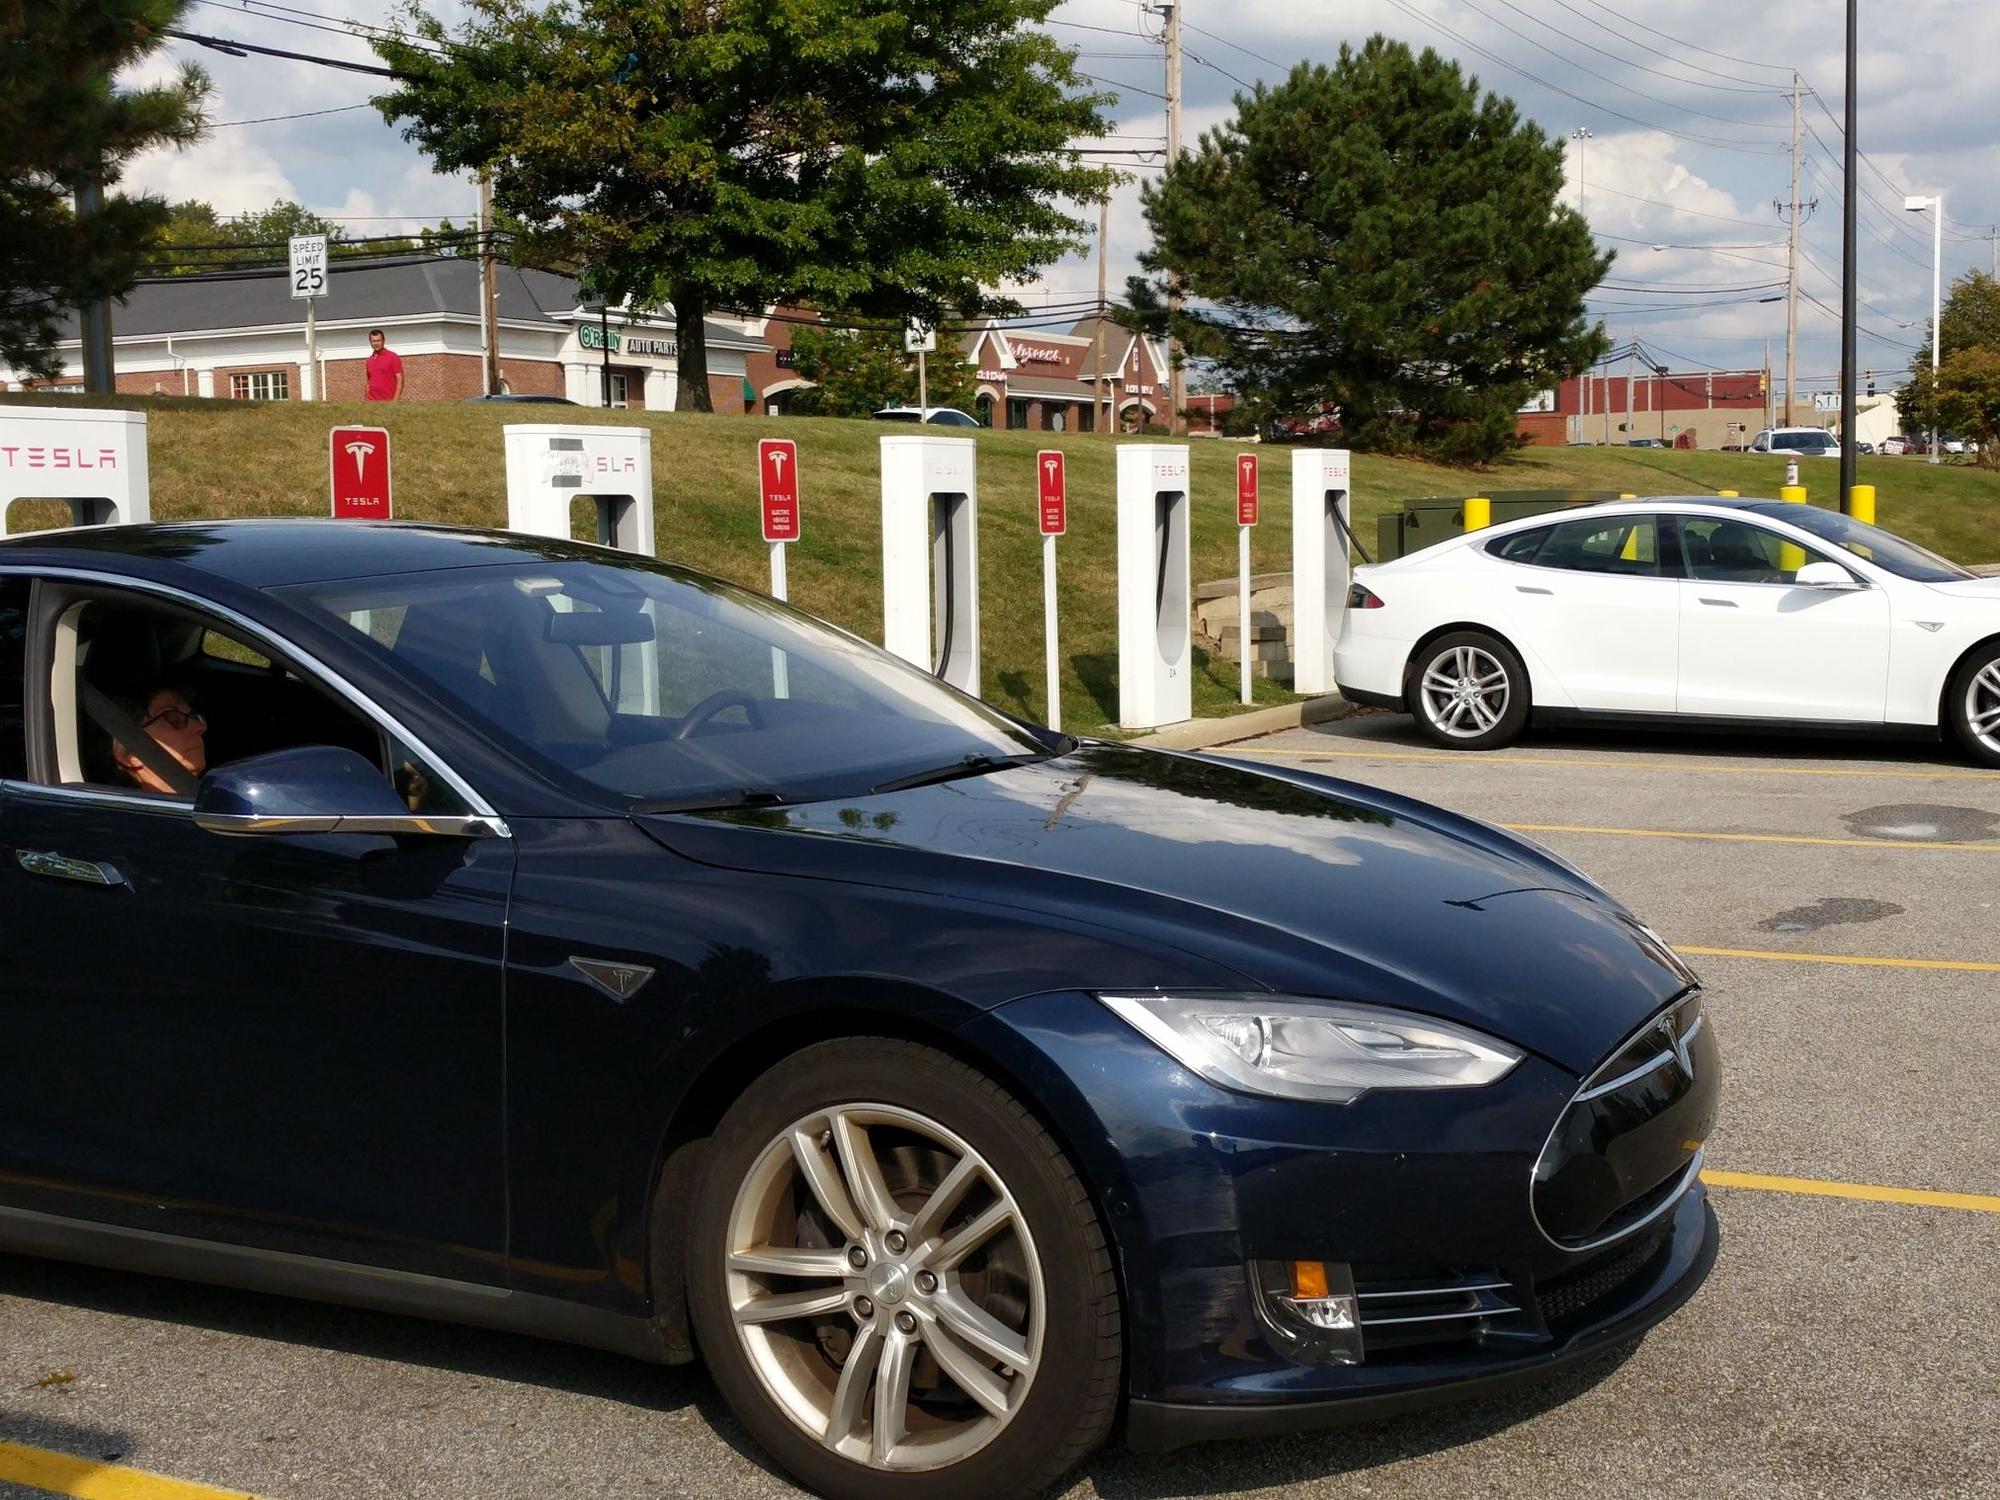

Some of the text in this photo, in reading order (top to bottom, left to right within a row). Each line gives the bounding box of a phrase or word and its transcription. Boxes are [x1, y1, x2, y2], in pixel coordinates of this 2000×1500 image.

[293, 242, 324, 254] SPEED
[296, 255, 320, 266] LIMIT
[296, 267, 323, 290] 25
[580, 325, 679, 355] O'Relly AUTO PARTS
[1008, 341, 1062, 363] algreens
[0, 447, 116, 469] TESLA
[597, 457, 635, 472] SLA
[1154, 465, 1185, 477] TESLA
[345, 497, 380, 506] TESLA
[1169, 668, 1176, 678] 2A
